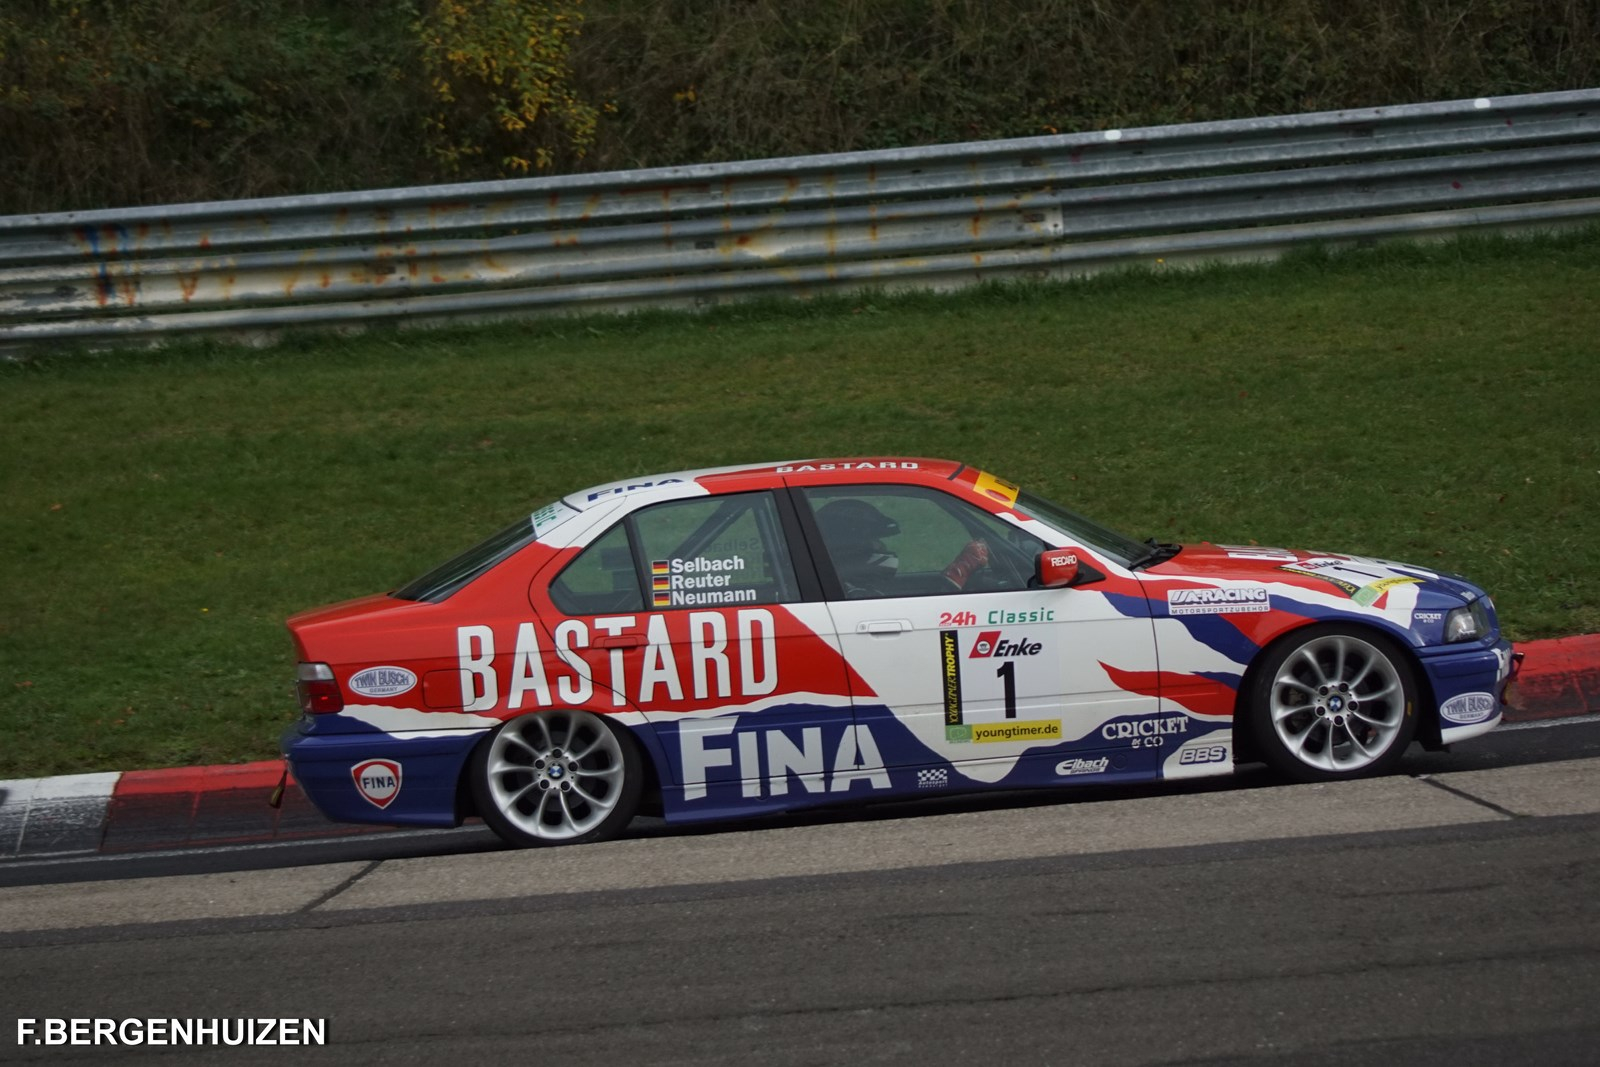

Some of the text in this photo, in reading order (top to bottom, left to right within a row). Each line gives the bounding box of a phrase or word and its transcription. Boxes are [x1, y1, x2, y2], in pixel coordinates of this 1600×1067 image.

[776, 461, 918, 473] BASTARD
[587, 478, 684, 502] FINA
[671, 555, 745, 574] Selbach
[671, 573, 731, 590] Reuter
[672, 588, 757, 606] Neumann
[939, 608, 1054, 626] 24h Classic
[993, 638, 1042, 657] Enke
[457, 608, 778, 712] BASTARD
[355, 670, 410, 688] TWIN BUSCH
[997, 661, 1016, 719] 1
[976, 724, 1058, 739] youngtimer.de
[1102, 716, 1188, 740] CRICKET
[1144, 736, 1164, 747] CO
[679, 715, 892, 801] FINA
[1179, 747, 1226, 765] BBS
[1055, 756, 1109, 775] Eibach
[362, 776, 396, 789] FINA
